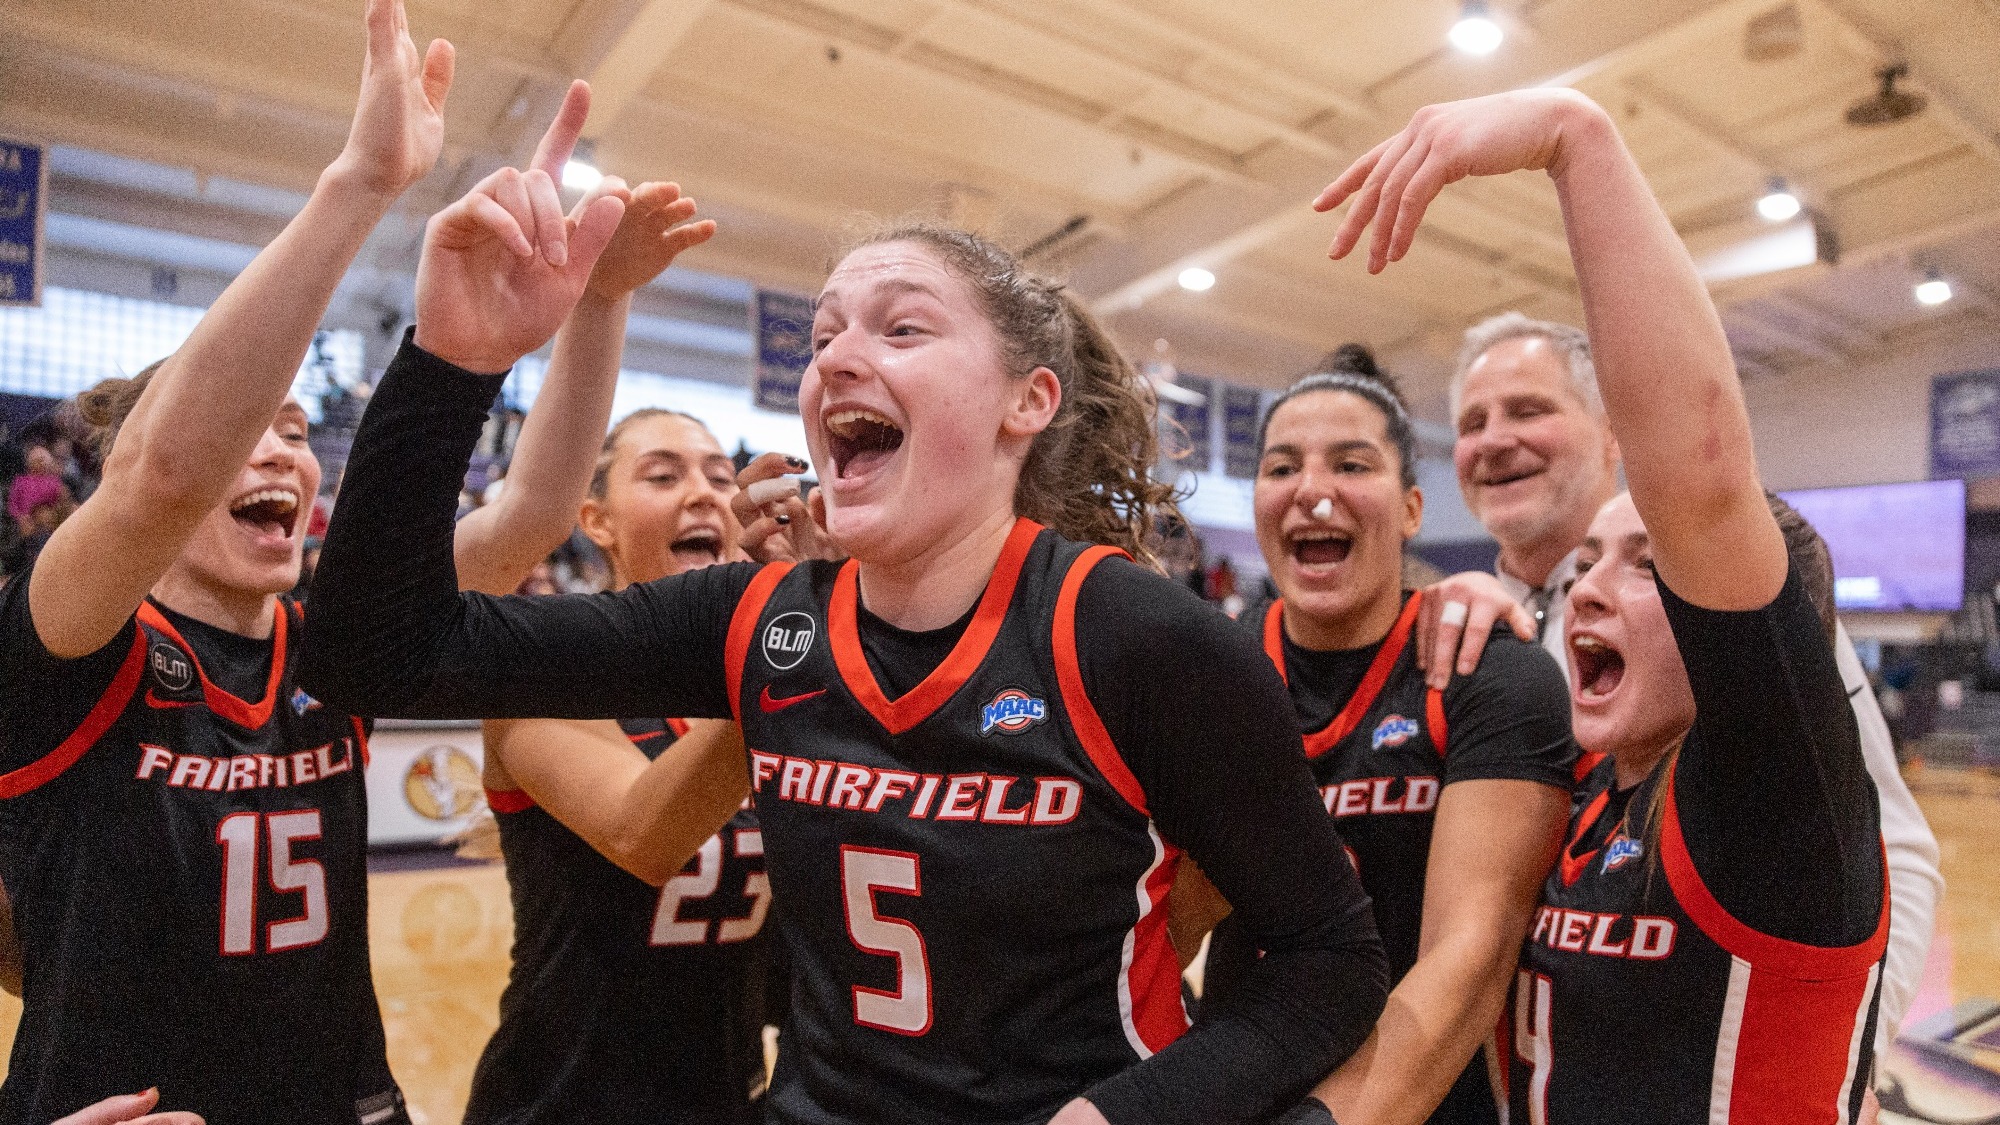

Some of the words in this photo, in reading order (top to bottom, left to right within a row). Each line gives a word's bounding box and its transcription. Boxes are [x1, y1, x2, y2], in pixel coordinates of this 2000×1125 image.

[154, 652, 189, 681] BLM
[766, 626, 812, 653] BLM
[981, 697, 1046, 733] MAAC
[135, 737, 353, 793] FAIRFIEL
[750, 748, 1085, 826] FAIRFIELD
[215, 808, 331, 957] 15
[648, 828, 773, 946] 23
[840, 843, 934, 1037] 5
